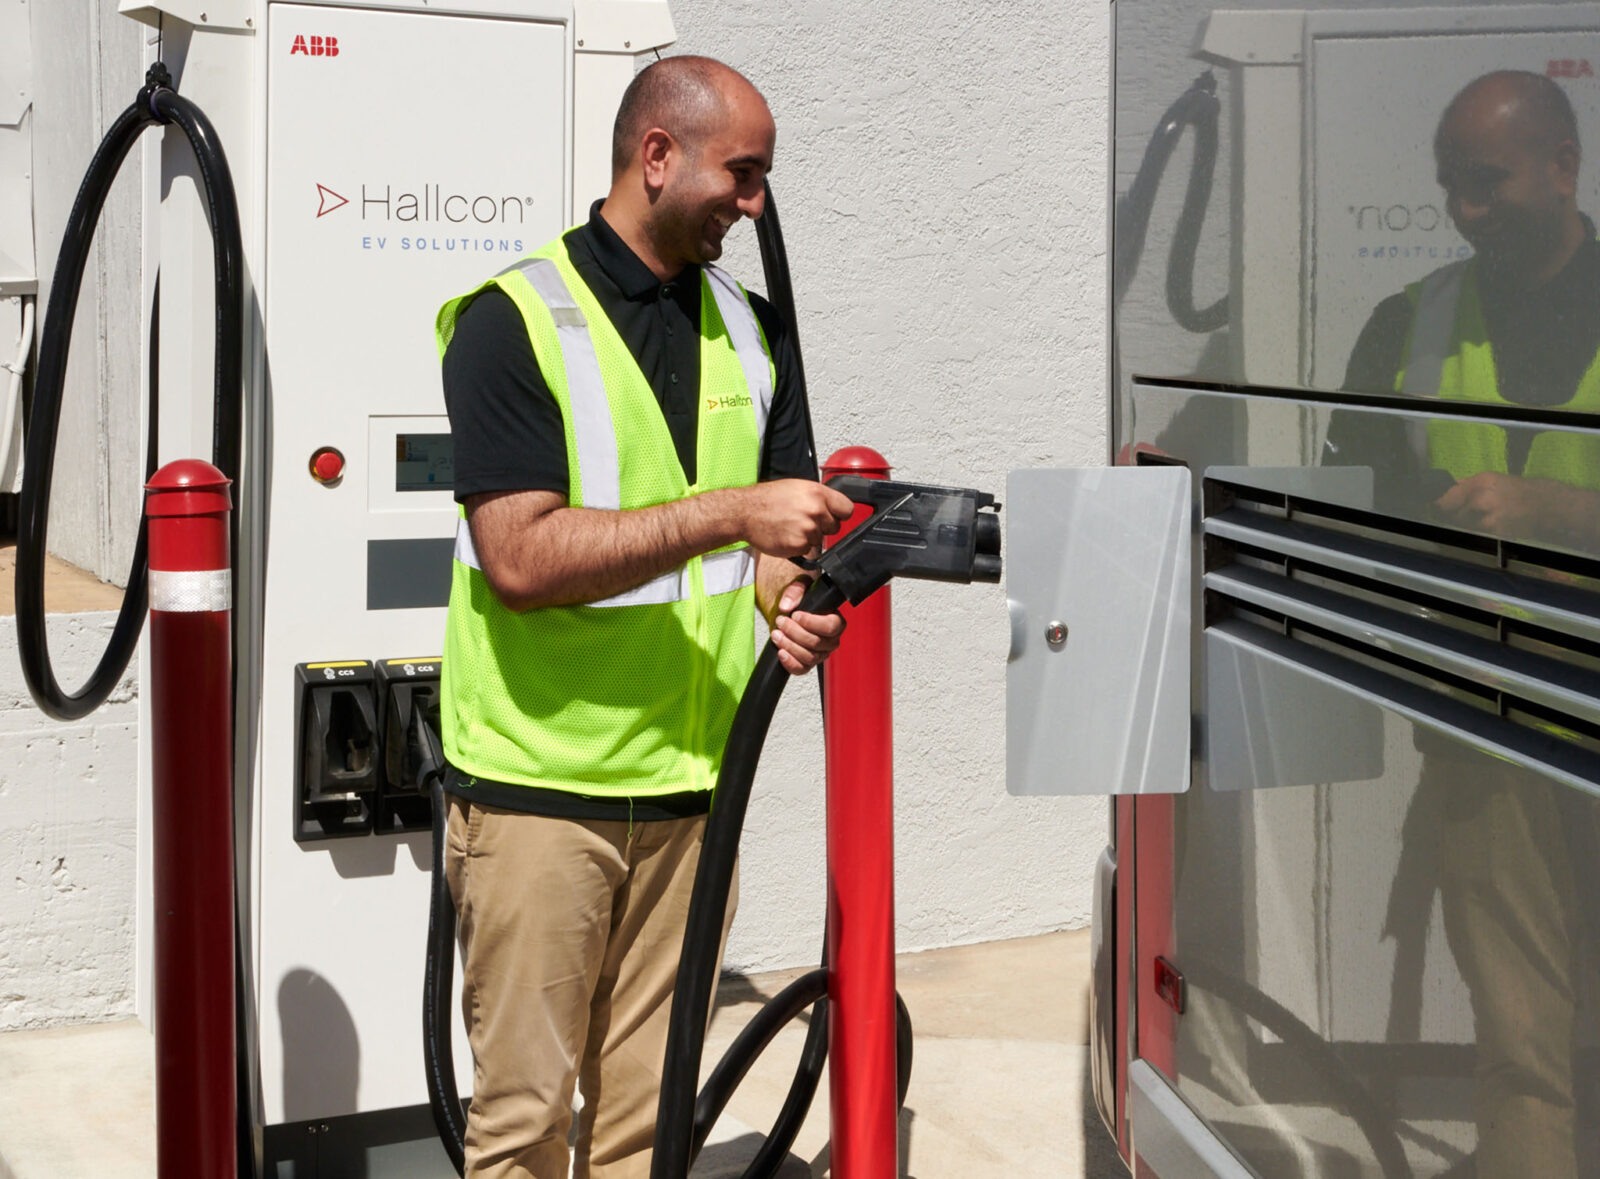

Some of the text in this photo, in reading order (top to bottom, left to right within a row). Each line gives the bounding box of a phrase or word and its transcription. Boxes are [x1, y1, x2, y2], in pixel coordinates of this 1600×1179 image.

[290, 35, 339, 56] ABB
[362, 237, 523, 252] EV SOLUTIONS
